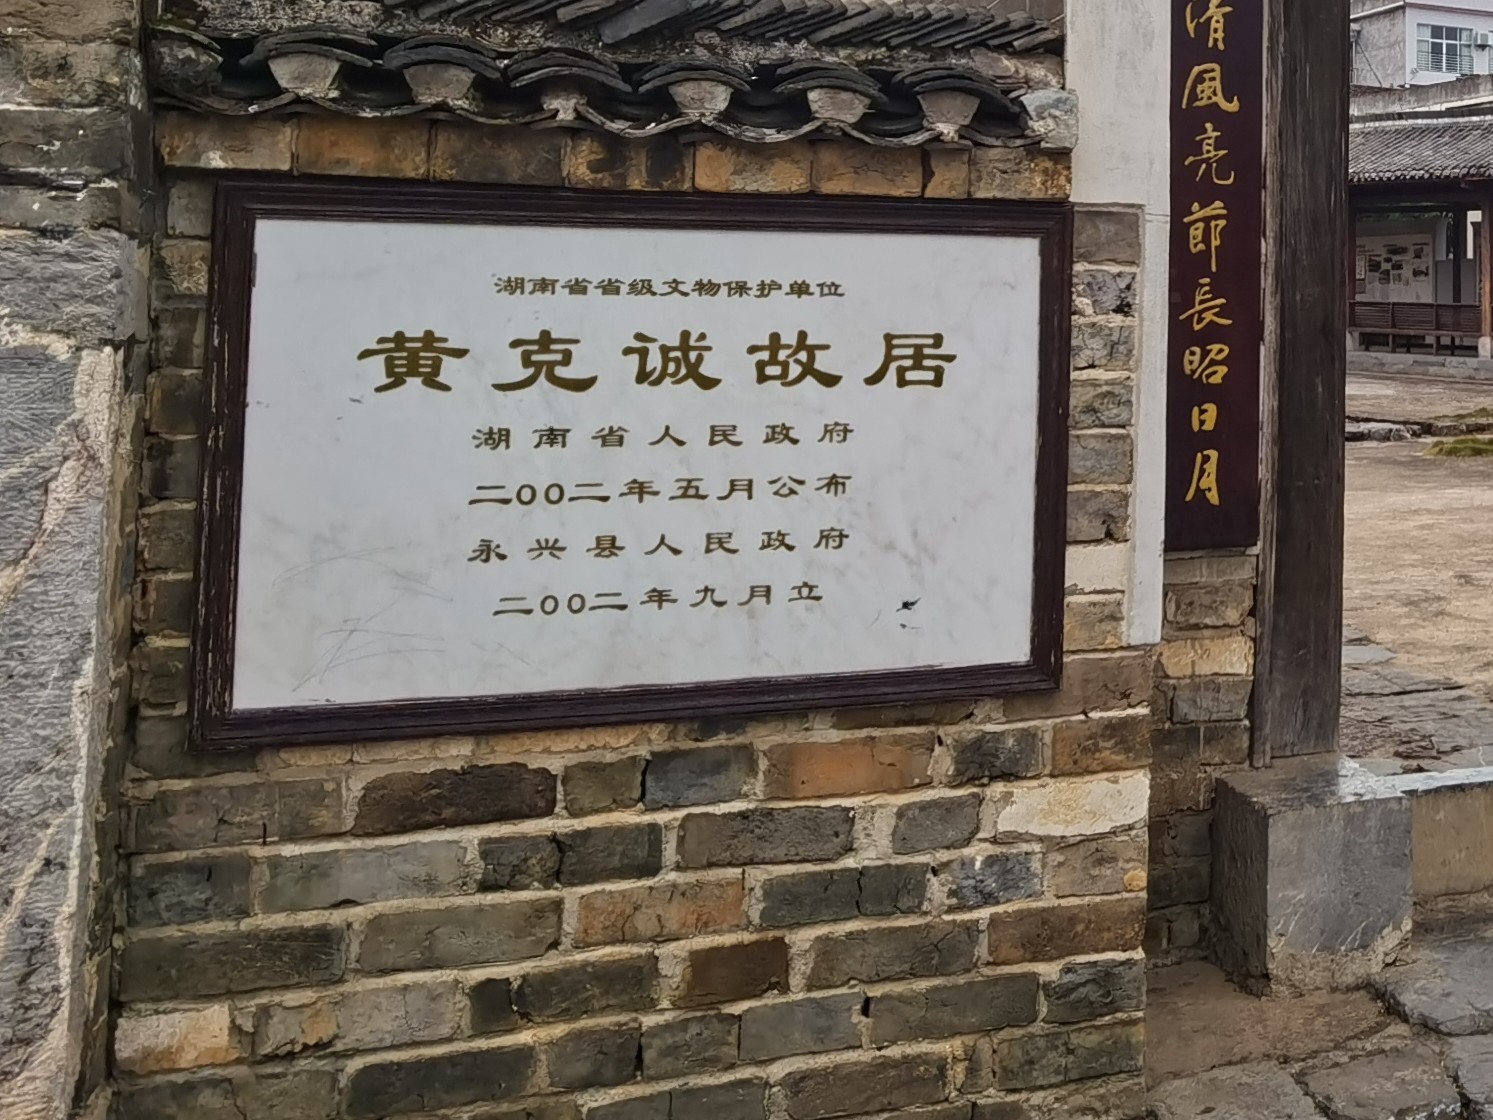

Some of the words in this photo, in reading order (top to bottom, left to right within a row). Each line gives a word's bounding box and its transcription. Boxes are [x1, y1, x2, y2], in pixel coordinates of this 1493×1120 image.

[493, 276, 845, 300] 湖南省省级文物保护单位
[356, 329, 958, 393] 黄克诚故居
[471, 421, 856, 452] 湖南省人民政府
[466, 526, 851, 563] 永兴县人民政府
